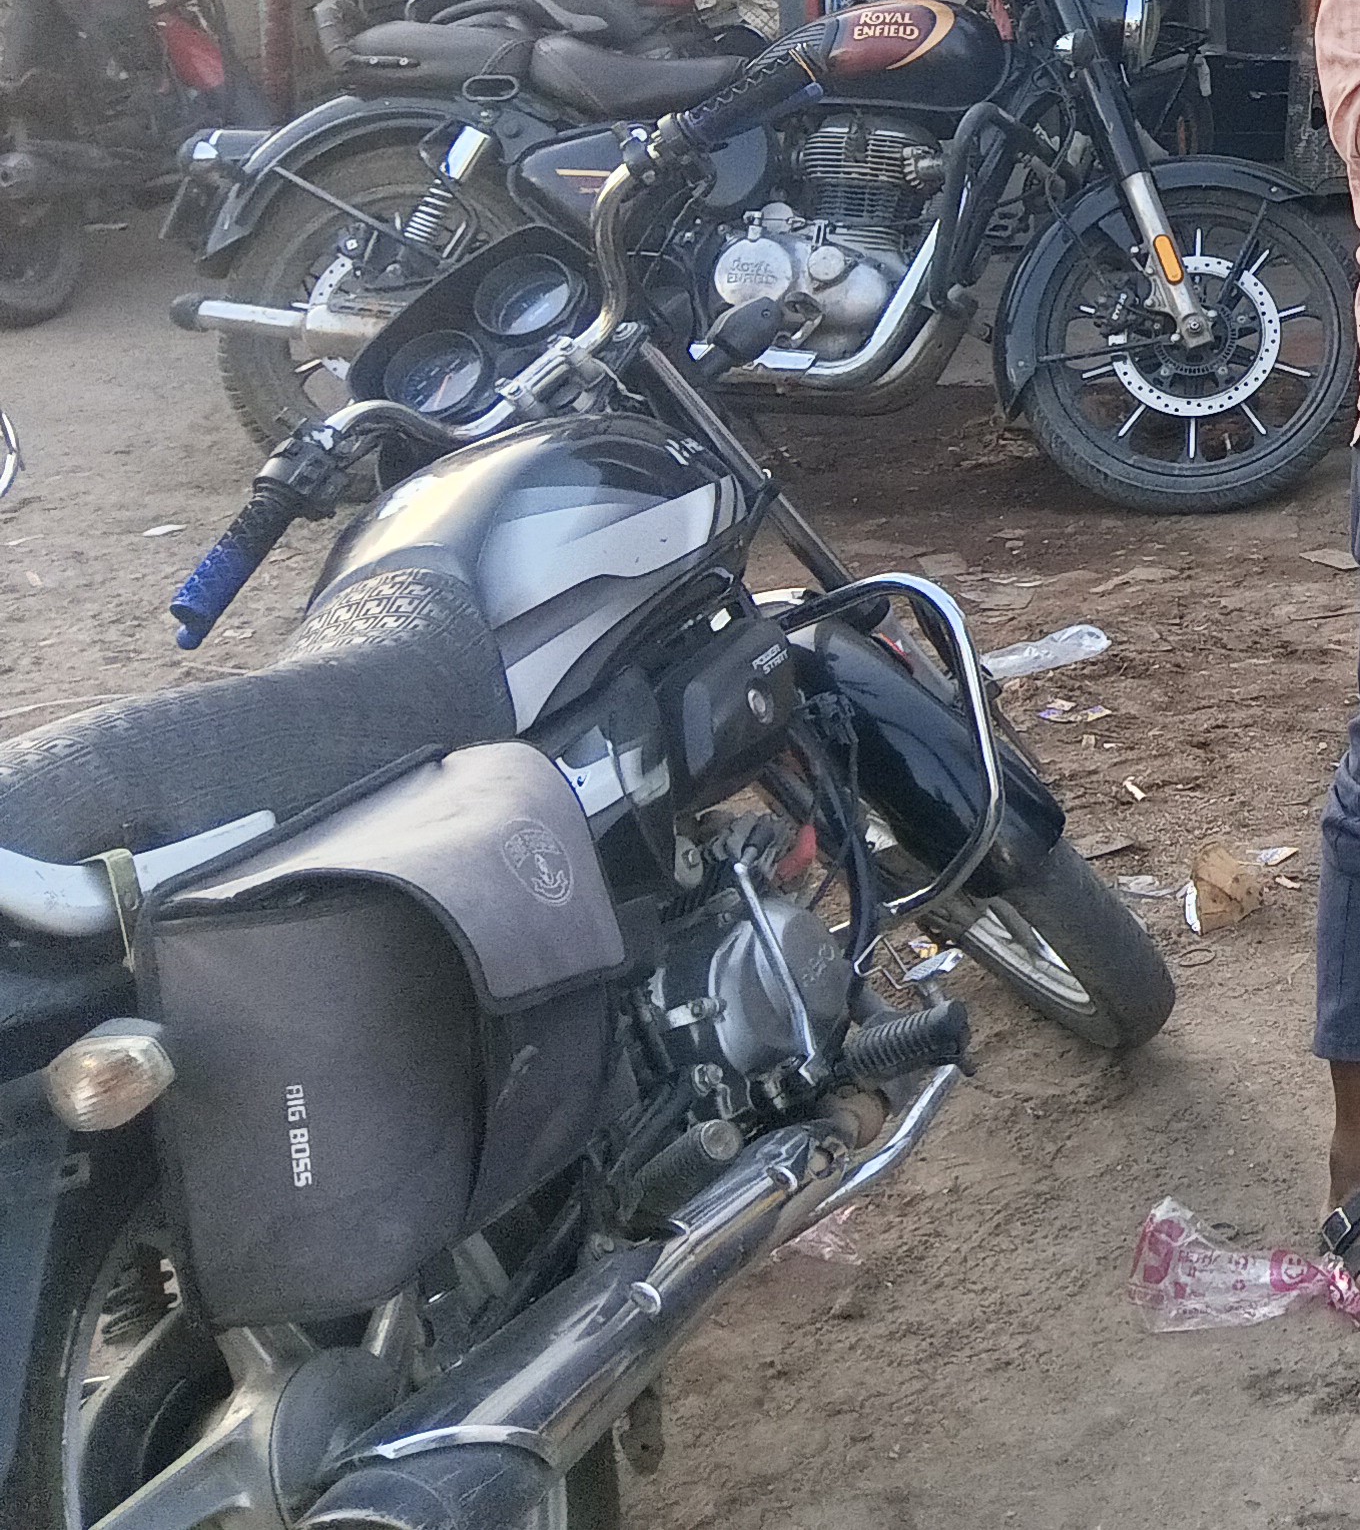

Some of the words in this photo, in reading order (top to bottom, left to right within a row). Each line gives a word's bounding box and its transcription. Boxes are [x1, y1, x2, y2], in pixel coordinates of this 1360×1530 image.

[860, 11, 914, 25] ROYAL
[853, 25, 919, 41] ENFIELD
[288, 1127, 313, 1188] BOSS
